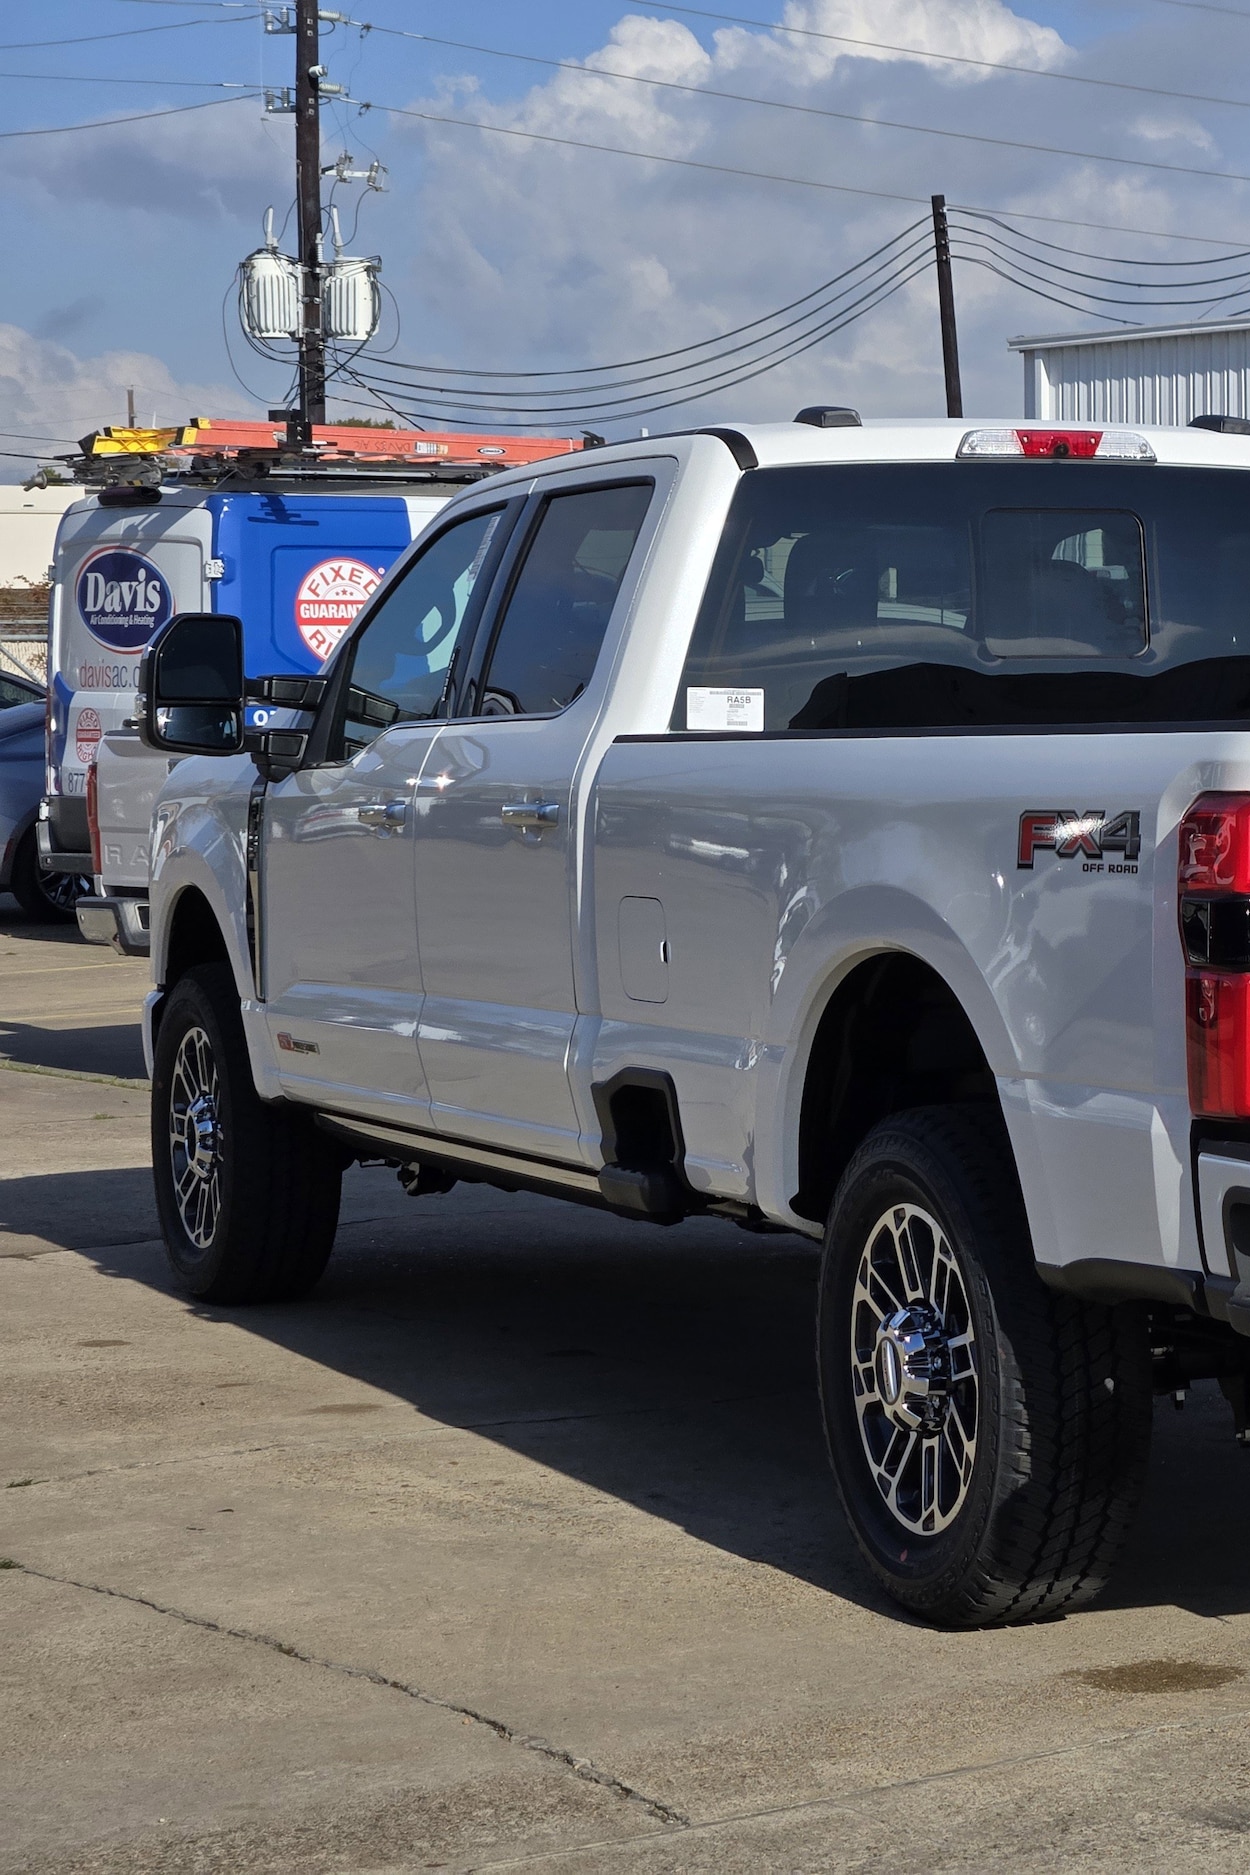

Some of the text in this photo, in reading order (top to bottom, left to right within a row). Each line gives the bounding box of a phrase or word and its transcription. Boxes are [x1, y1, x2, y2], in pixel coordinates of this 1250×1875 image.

[84, 568, 161, 613] Davis
[133, 614, 155, 629] Heating
[1017, 809, 1141, 870] FX4
[1083, 863, 1138, 874] OFF ROAD
